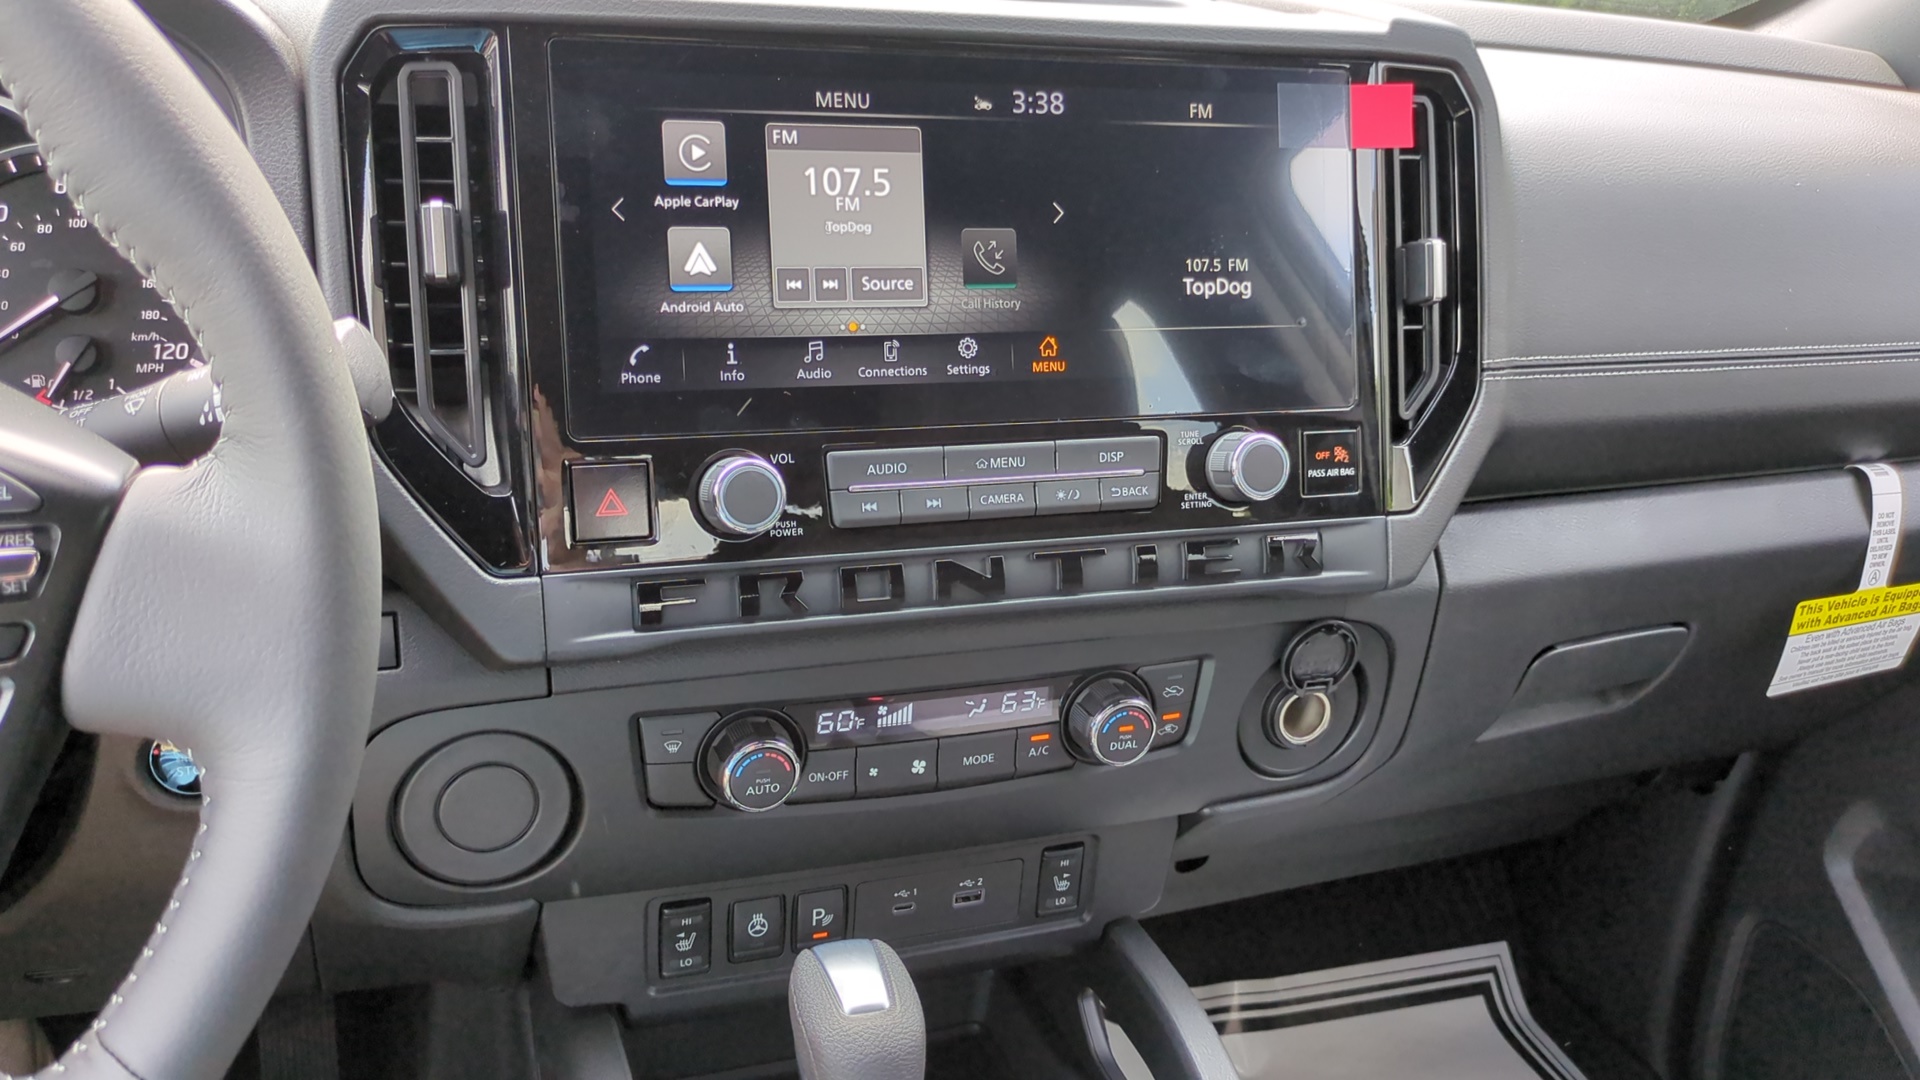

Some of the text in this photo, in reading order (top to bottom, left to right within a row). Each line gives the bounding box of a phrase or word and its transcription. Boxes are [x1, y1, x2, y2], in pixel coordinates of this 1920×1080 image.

[815, 91, 870, 109] MENU
[1012, 90, 1065, 115] 3:38
[1188, 102, 1213, 120] FM
[772, 129, 798, 145] FM
[803, 166, 892, 197] 107.5
[653, 194, 739, 210] Apple CarPlay
[835, 196, 861, 212] FM
[36, 224, 53, 234] 80
[67, 218, 88, 229] 100
[825, 220, 873, 235] TopDog
[9, 242, 26, 252] 60
[1184, 258, 1249, 273] 107.5 FM
[861, 274, 914, 292] Source
[1182, 277, 1253, 300] TopDog
[660, 301, 744, 314] Android Auto
[961, 297, 1021, 313] Call History
[140, 310, 160, 320] 180
[130, 331, 160, 342] km/h
[153, 342, 189, 361] 120
[135, 362, 165, 374] MPH
[796, 366, 832, 380] Audio
[857, 365, 928, 379] Connections
[946, 362, 991, 378] Settings
[1031, 360, 1066, 374] MENU
[620, 371, 662, 385] Phone
[719, 370, 746, 383] Info
[108, 378, 115, 390] 1
[72, 389, 94, 401] 1/2
[1179, 429, 1200, 439] TUNE
[1177, 436, 1204, 446] SCROLL
[769, 453, 796, 466] VOL
[1098, 451, 1125, 464] DISP
[1314, 450, 1331, 461] OFF
[866, 462, 909, 477] AUDIO
[988, 456, 1027, 470] MENU
[1307, 467, 1356, 479] PASS AIR BAG
[1121, 485, 1150, 498] BACK
[1183, 492, 1209, 502] ENTER
[979, 492, 1026, 506] CAMERA
[1180, 499, 1214, 511] SETTING
[775, 521, 798, 530] PUSH
[769, 528, 805, 539] POWER
[635, 529, 1325, 633] FRONTIER
[1799, 588, 1920, 617] This Vehicle is Equipp
[1796, 618, 1822, 631] with
[1823, 607, 1879, 627] Advanced
[1880, 604, 1896, 615] Air
[1028, 745, 1050, 758] A/C
[1109, 740, 1138, 751] DUAL
[962, 753, 995, 766] MODE
[745, 783, 781, 797] AUTO
[1059, 859, 1070, 867] HI
[977, 877, 984, 886] 2
[912, 888, 918, 896] 1
[1055, 897, 1067, 906] LO
[681, 918, 693, 927] HI
[679, 958, 693, 968] LO
